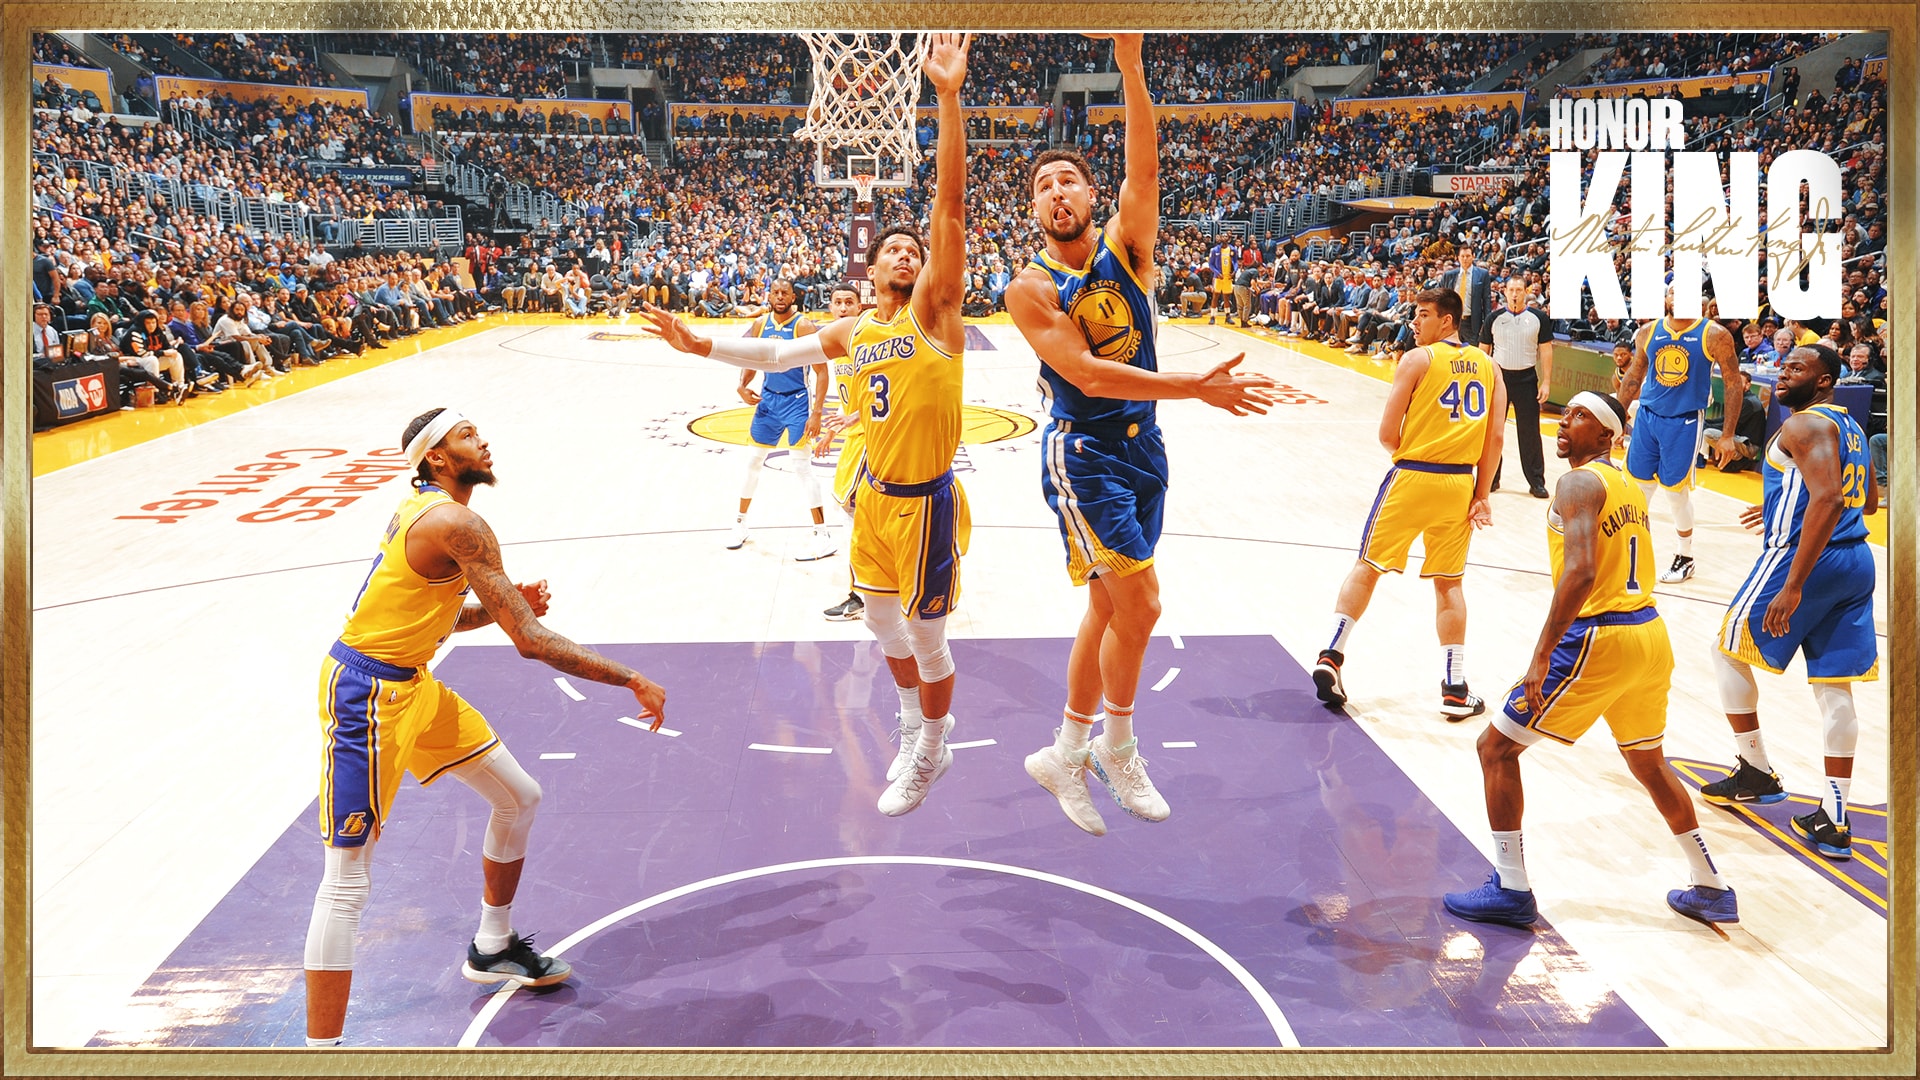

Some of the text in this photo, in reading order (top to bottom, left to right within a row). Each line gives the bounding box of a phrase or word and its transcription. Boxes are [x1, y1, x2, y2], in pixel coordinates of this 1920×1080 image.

[159, 79, 180, 89] 114
[413, 96, 431, 106] 115
[1088, 108, 1104, 118] 116
[366, 173, 406, 181] EXPRESS
[1089, 279, 1121, 291] STATE
[1098, 297, 1116, 320] 11
[854, 335, 915, 374] LAKERS
[1674, 356, 1681, 365] 0
[1450, 360, 1478, 375] ZUBAC
[58, 387, 80, 411] NBA
[869, 374, 890, 420] 3
[1438, 380, 1487, 422] 40
[112, 447, 349, 525] Center
[1841, 462, 1867, 509] 23
[1625, 535, 1642, 595] 1
